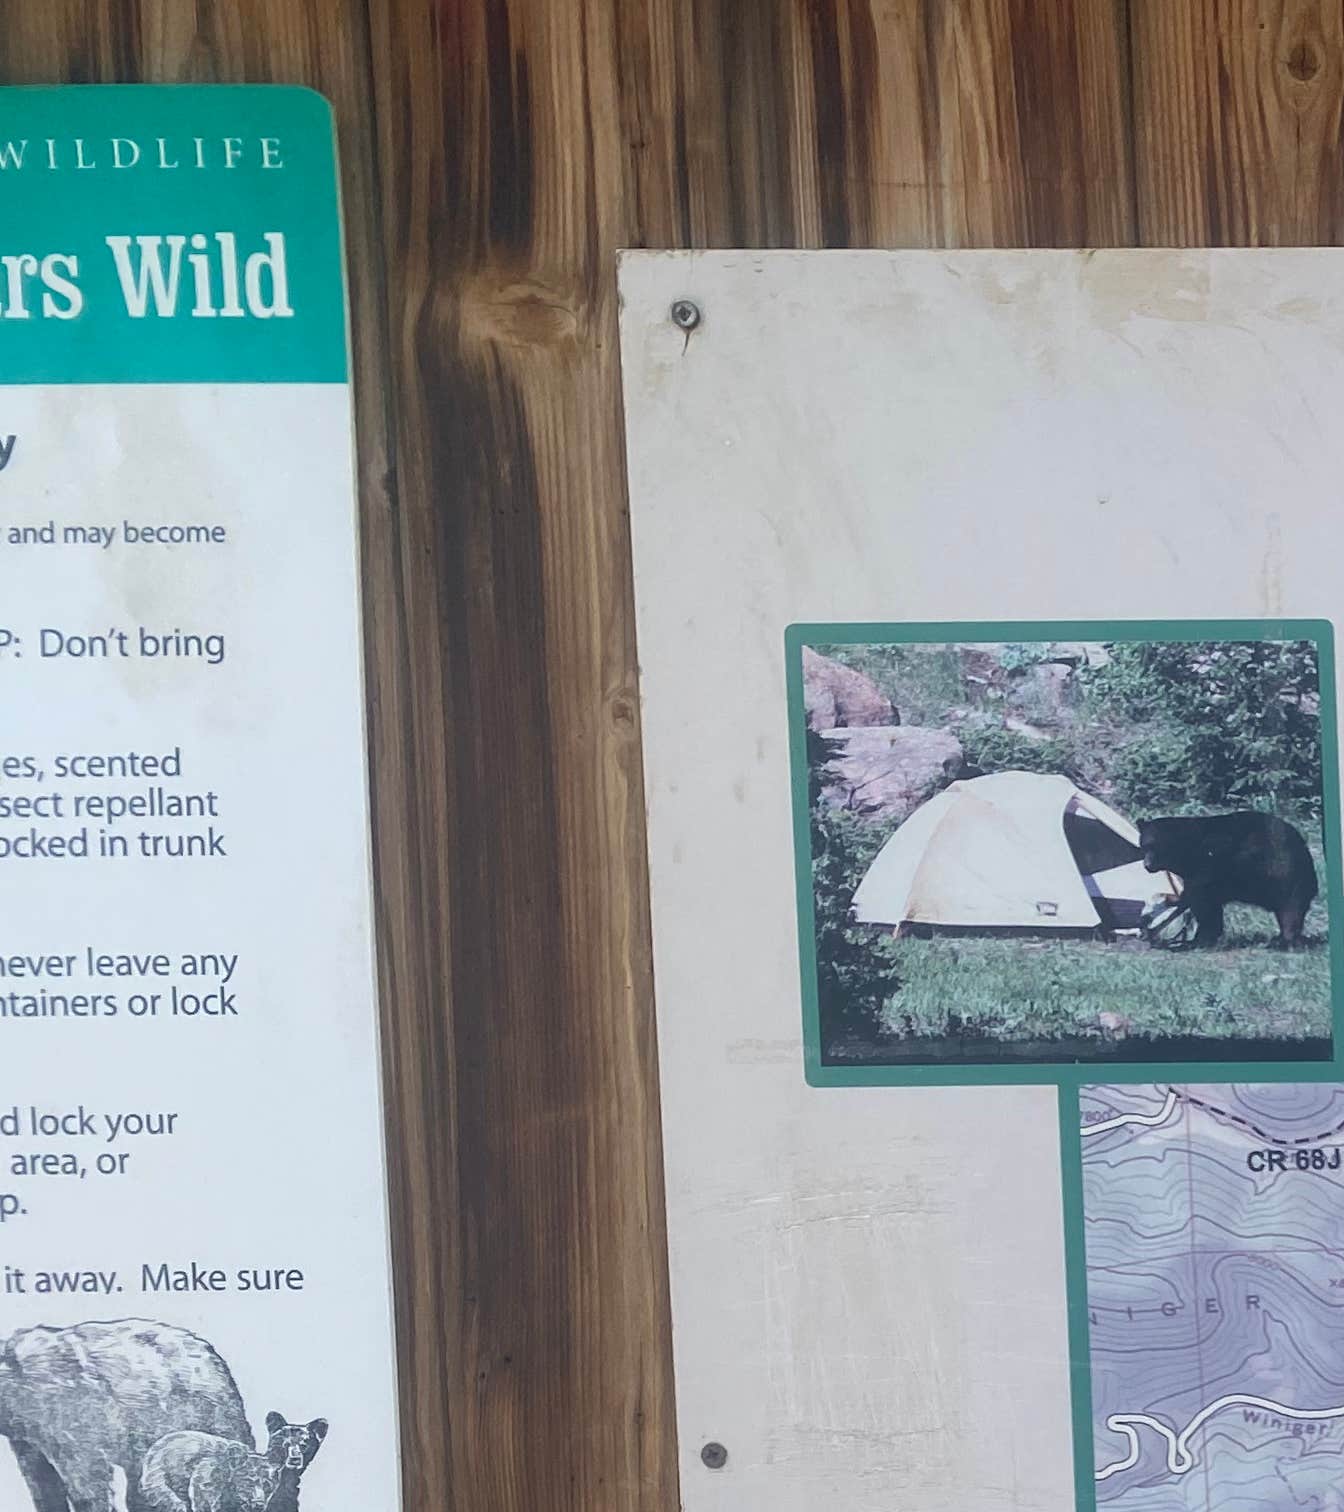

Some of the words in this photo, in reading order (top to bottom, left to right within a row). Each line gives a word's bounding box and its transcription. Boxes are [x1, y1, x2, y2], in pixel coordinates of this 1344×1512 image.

[106, 233, 294, 318] Wild
[8, 521, 55, 544] and
[64, 527, 116, 549] may
[124, 520, 226, 543] become
[41, 628, 129, 657] Don't
[140, 627, 224, 664] bring
[55, 747, 180, 777] scented
[75, 787, 218, 824] repellant
[88, 947, 170, 976] leave
[181, 955, 238, 983] any
[1248, 1151, 1288, 1172] CR
[1295, 1149, 1341, 1170] 68J
[5, 1266, 26, 1293] it
[35, 1272, 122, 1294] away.
[142, 1262, 226, 1291] Make
[238, 1270, 303, 1290] sure
